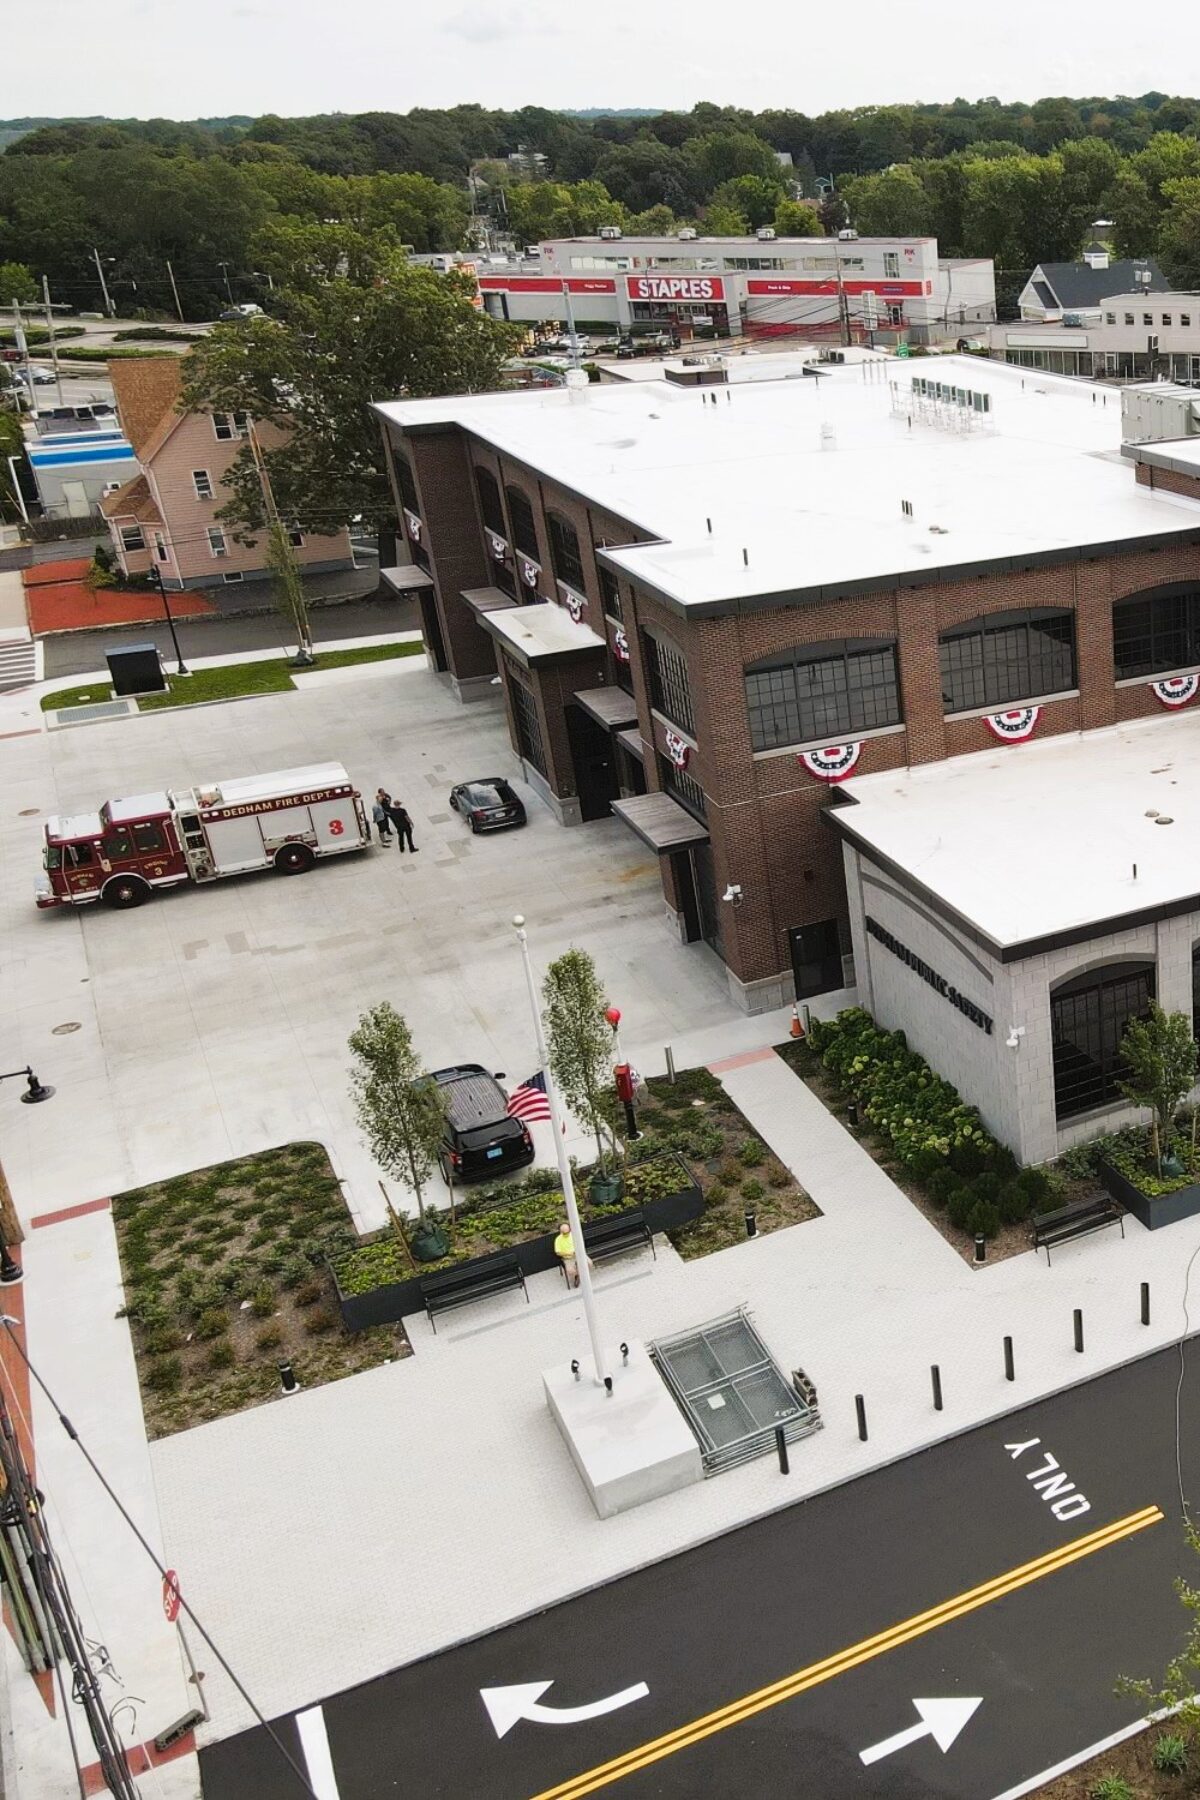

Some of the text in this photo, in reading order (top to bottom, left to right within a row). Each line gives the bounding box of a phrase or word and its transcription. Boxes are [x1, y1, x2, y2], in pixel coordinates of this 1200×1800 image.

[638, 279, 714, 299] STAPLES
[222, 803, 273, 818] DEDHAM
[275, 796, 301, 808] FIRE
[328, 819, 344, 836] 3
[1004, 1437, 1091, 1521] ONLY
